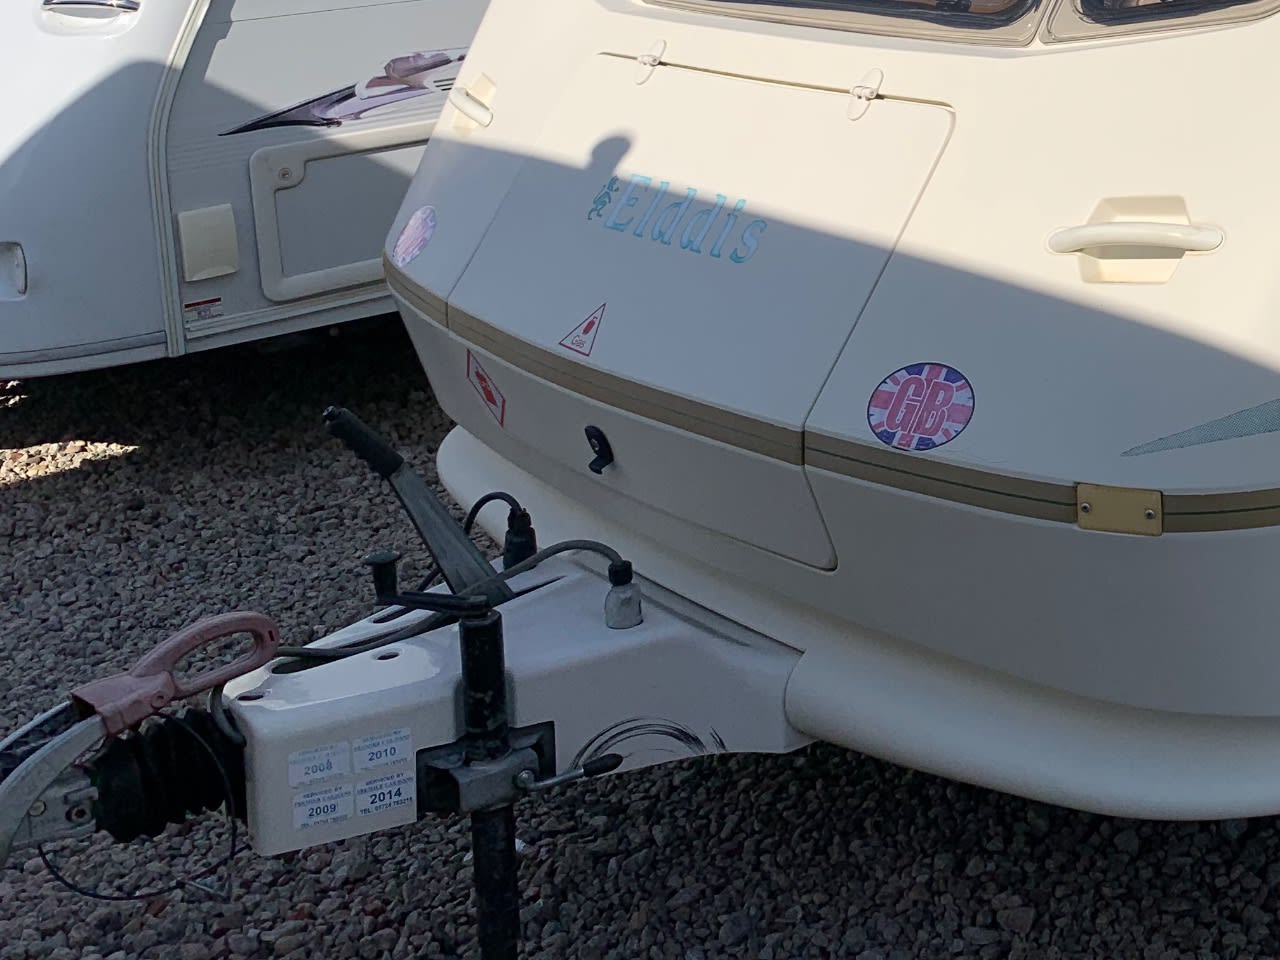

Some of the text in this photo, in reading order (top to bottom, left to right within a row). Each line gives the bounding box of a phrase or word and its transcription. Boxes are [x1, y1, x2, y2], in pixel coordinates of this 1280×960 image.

[605, 174, 768, 264] Elddis
[885, 375, 955, 437] GB
[368, 746, 397, 762] 2010
[304, 759, 333, 777] 2008
[370, 787, 402, 805] 2014
[308, 803, 337, 817] 2009
